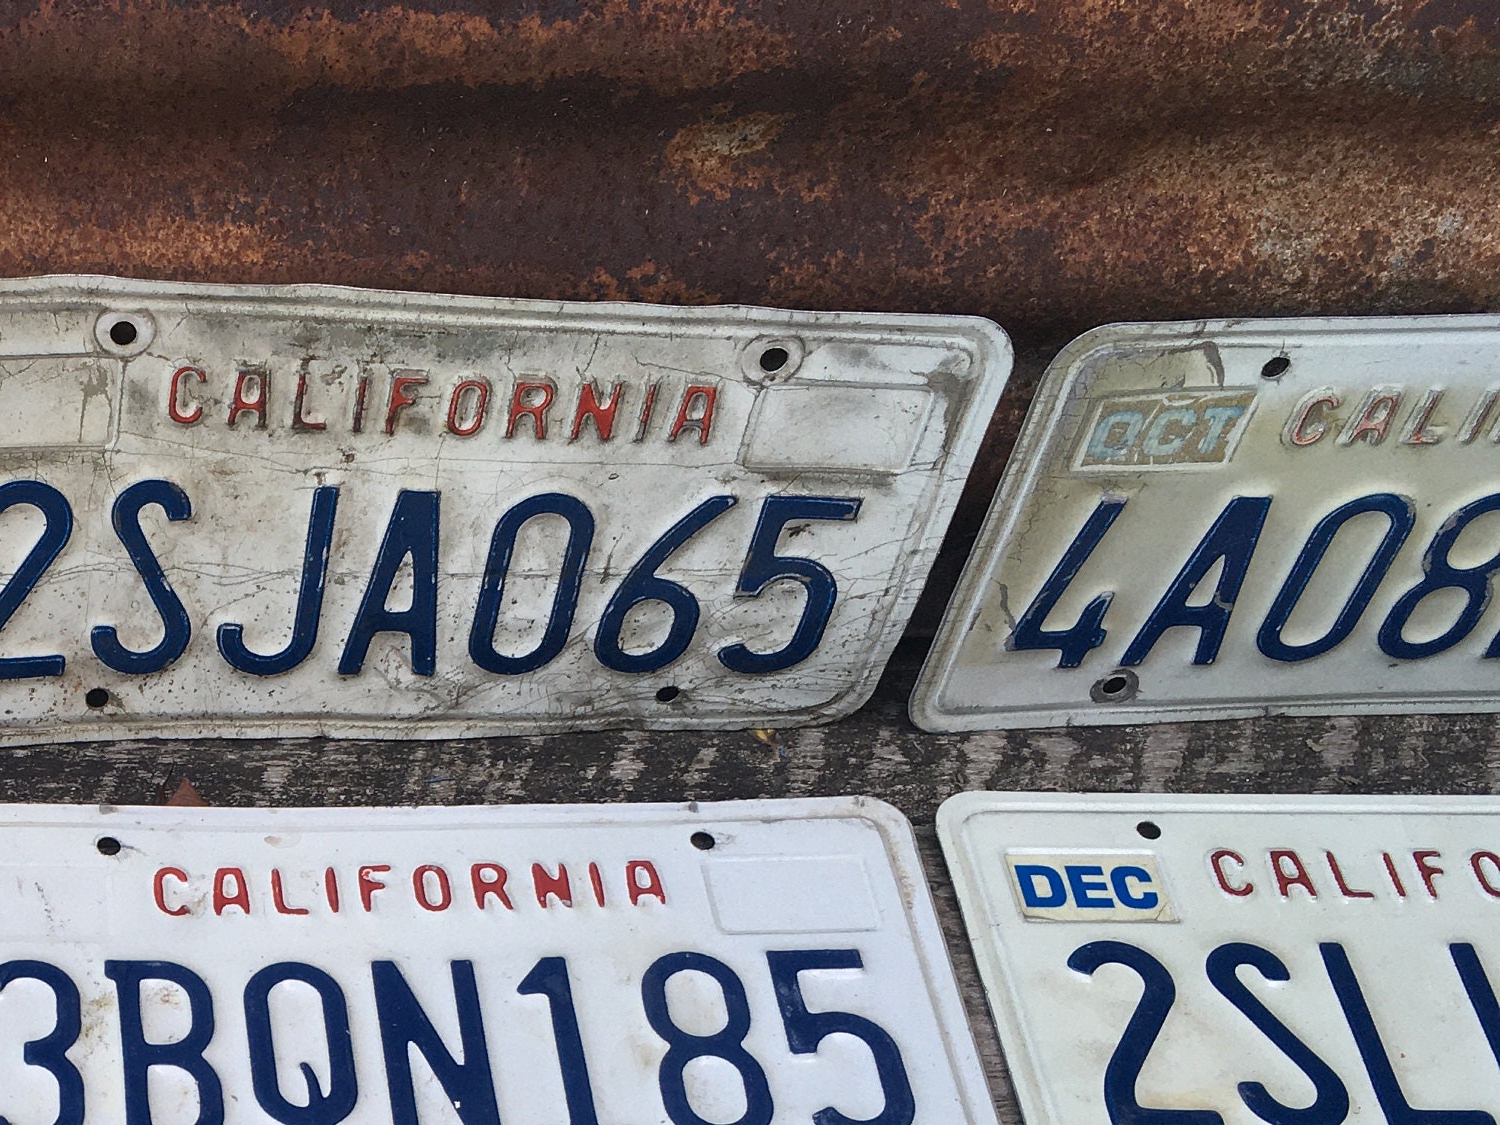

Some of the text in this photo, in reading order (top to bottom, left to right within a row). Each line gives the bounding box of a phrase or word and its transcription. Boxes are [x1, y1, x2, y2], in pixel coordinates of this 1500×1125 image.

[167, 364, 718, 444] CALIFORNIA
[1088, 404, 1246, 459] OCT
[1284, 387, 1500, 444] CALI
[1006, 493, 1500, 667] 4A08
[152, 859, 667, 917] CALIFORNIA
[1014, 865, 1160, 910] DEC
[1211, 850, 1500, 898] CALIFO
